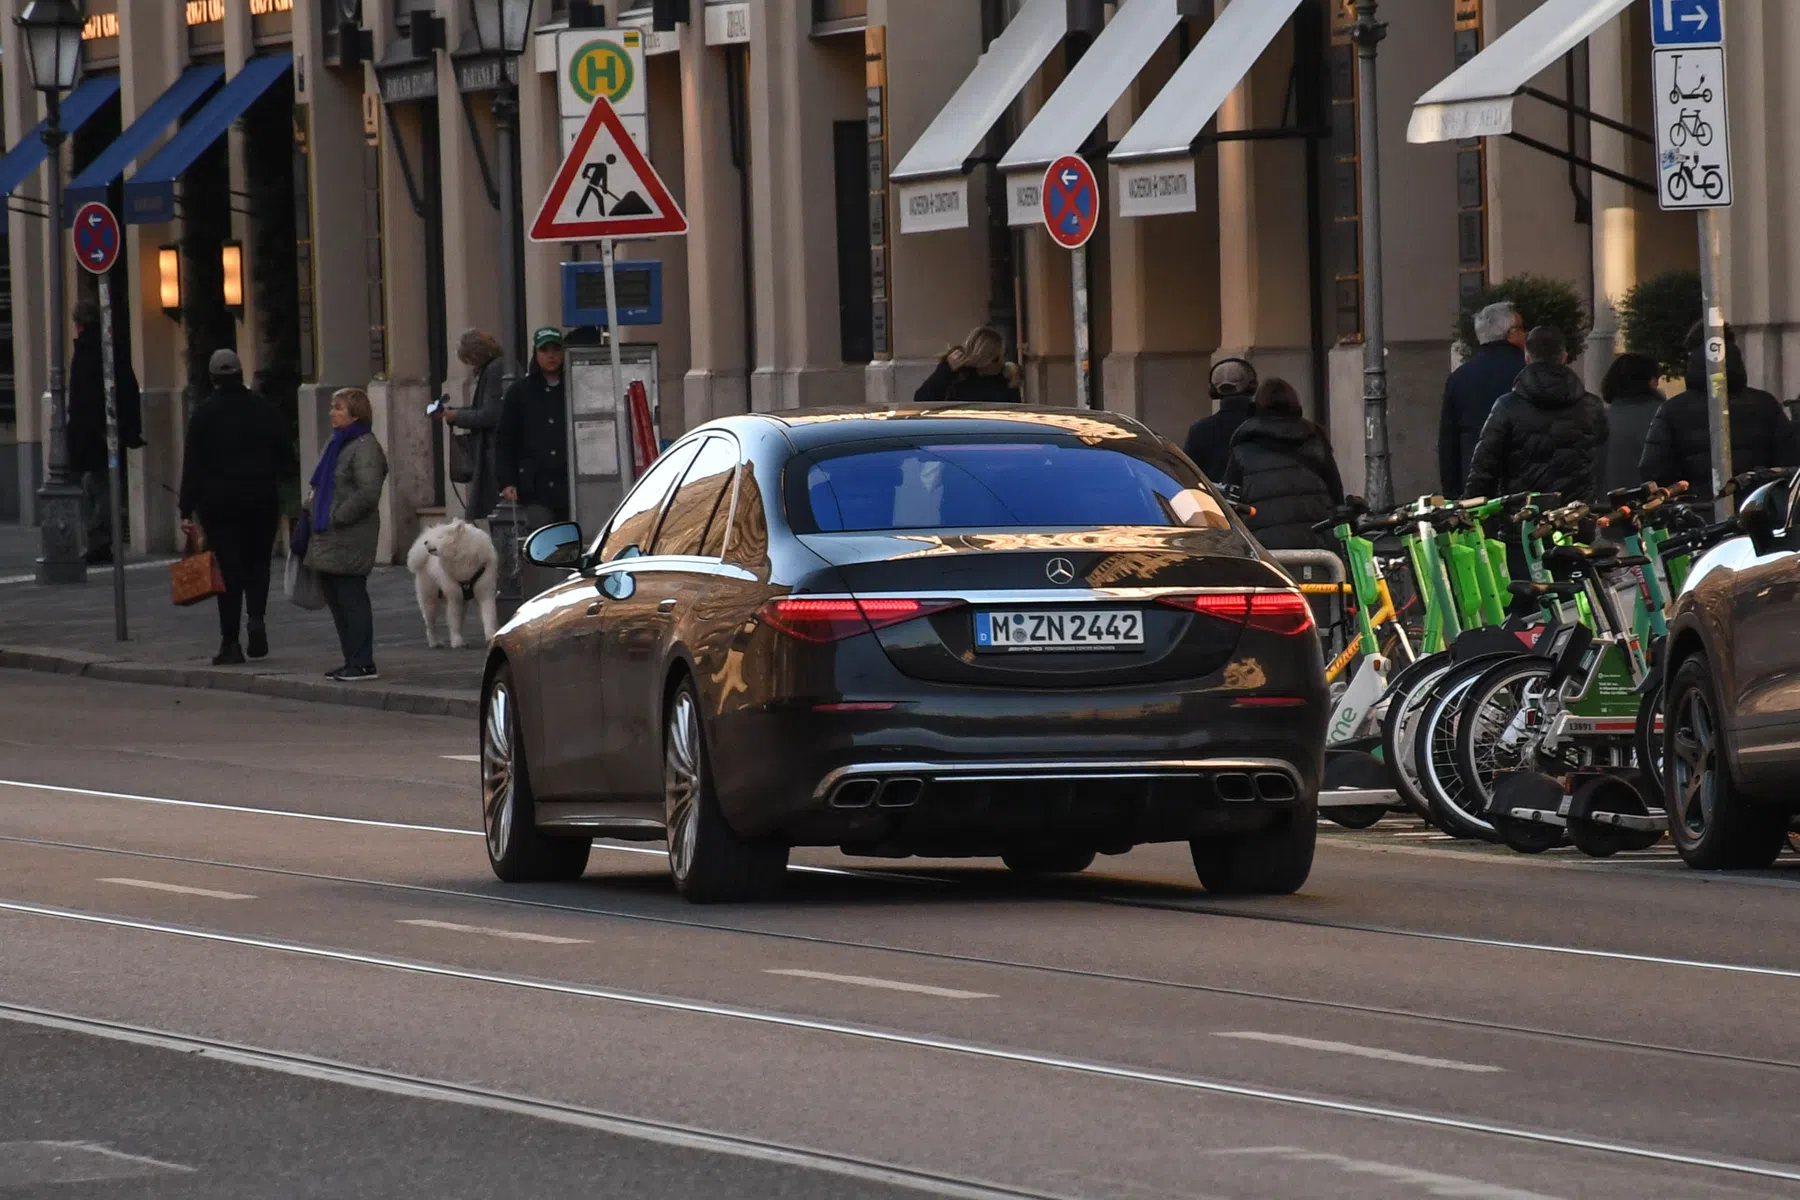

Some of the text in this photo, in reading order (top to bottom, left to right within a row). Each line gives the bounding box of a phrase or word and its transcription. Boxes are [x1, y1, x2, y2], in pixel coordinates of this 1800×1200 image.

[586, 55, 616, 91] H
[980, 633, 987, 641] D
[991, 615, 1010, 642] M
[1070, 614, 1139, 641] 2442
